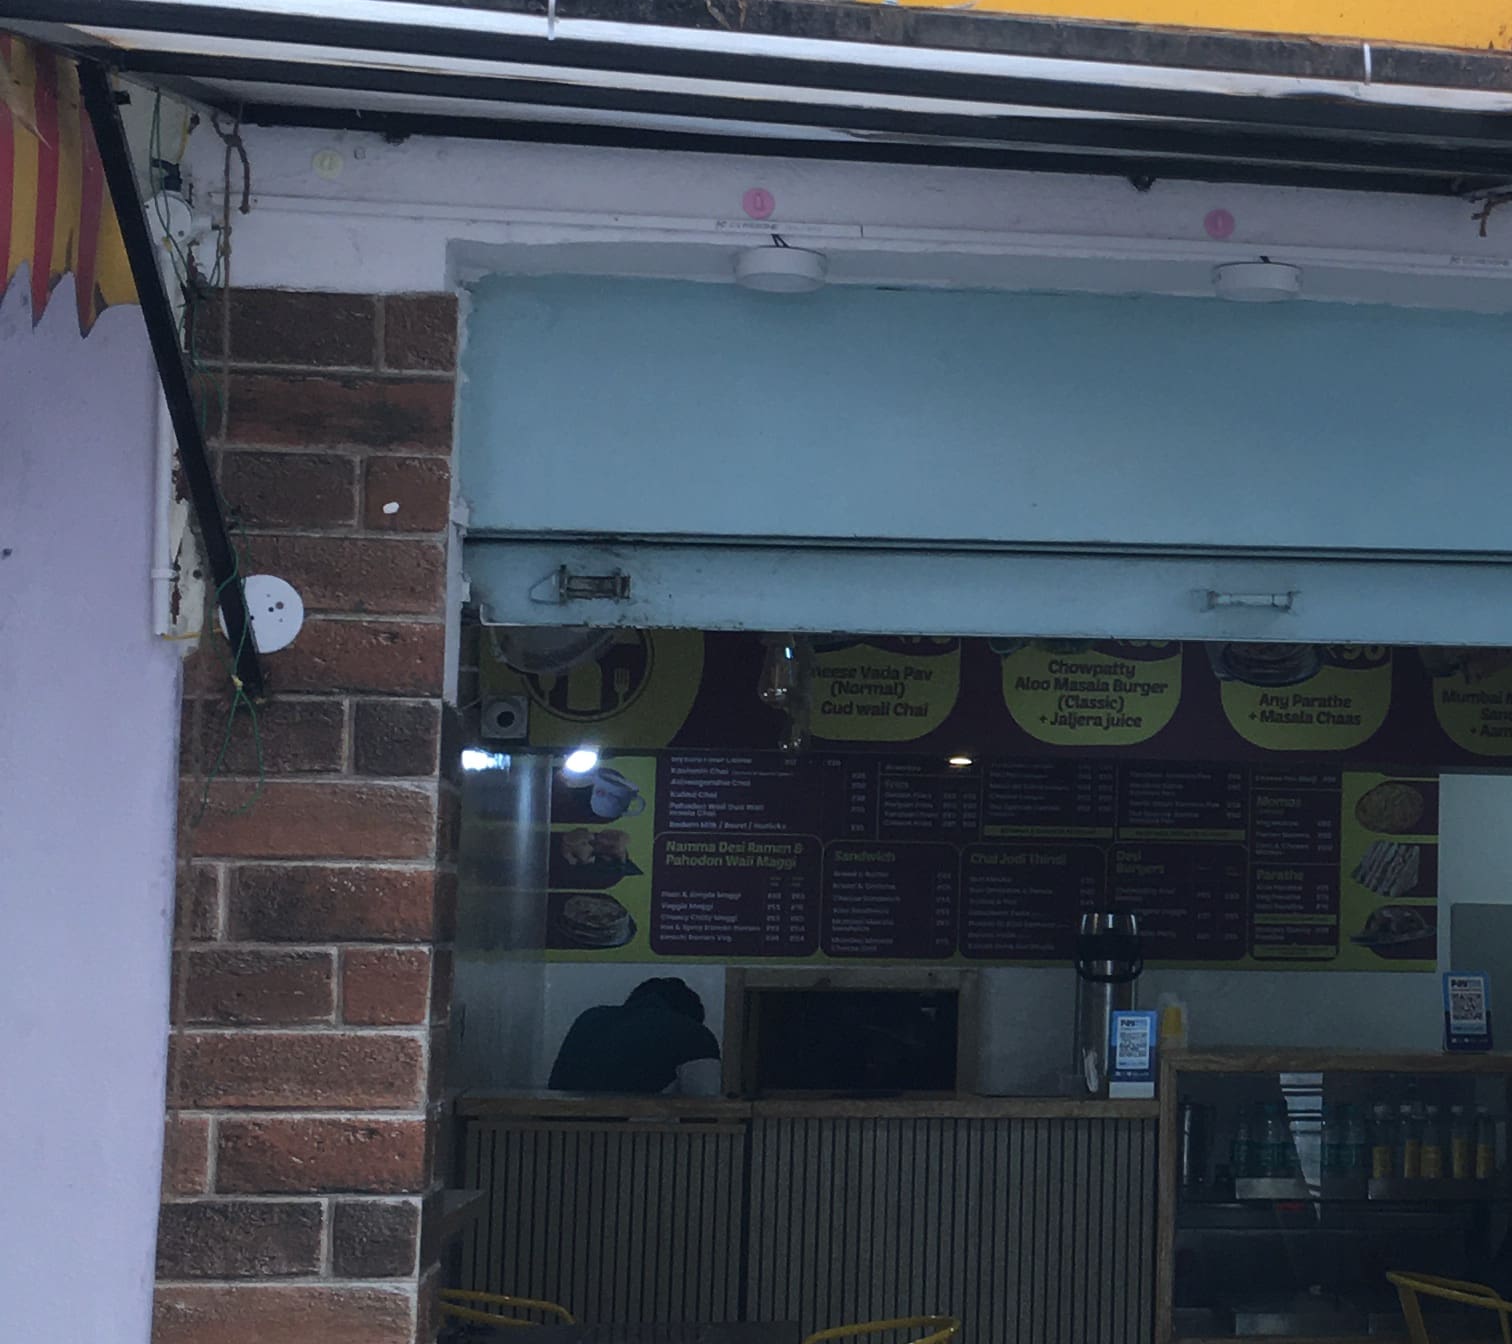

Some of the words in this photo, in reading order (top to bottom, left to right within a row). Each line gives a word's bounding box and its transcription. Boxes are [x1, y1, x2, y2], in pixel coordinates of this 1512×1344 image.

[861, 666, 899, 680] Vada
[904, 667, 933, 681] Pav
[1047, 659, 1136, 679] Chowpatty
[830, 681, 905, 698] (Normal)
[1015, 676, 1050, 691] Aloo
[1053, 677, 1110, 693] Masala
[1113, 678, 1169, 696] Burger
[821, 701, 854, 715] Gud
[894, 702, 929, 717] Chai
[1057, 694, 1125, 713] (Classic)
[1259, 693, 1289, 709] Any
[1050, 712, 1103, 730] Jaljera
[1103, 713, 1143, 730] juice
[1259, 709, 1313, 723] Masala
[666, 840, 716, 854] Namma
[718, 840, 747, 854] Desi
[748, 841, 792, 854] Ramen
[756, 855, 797, 870] Maggi
